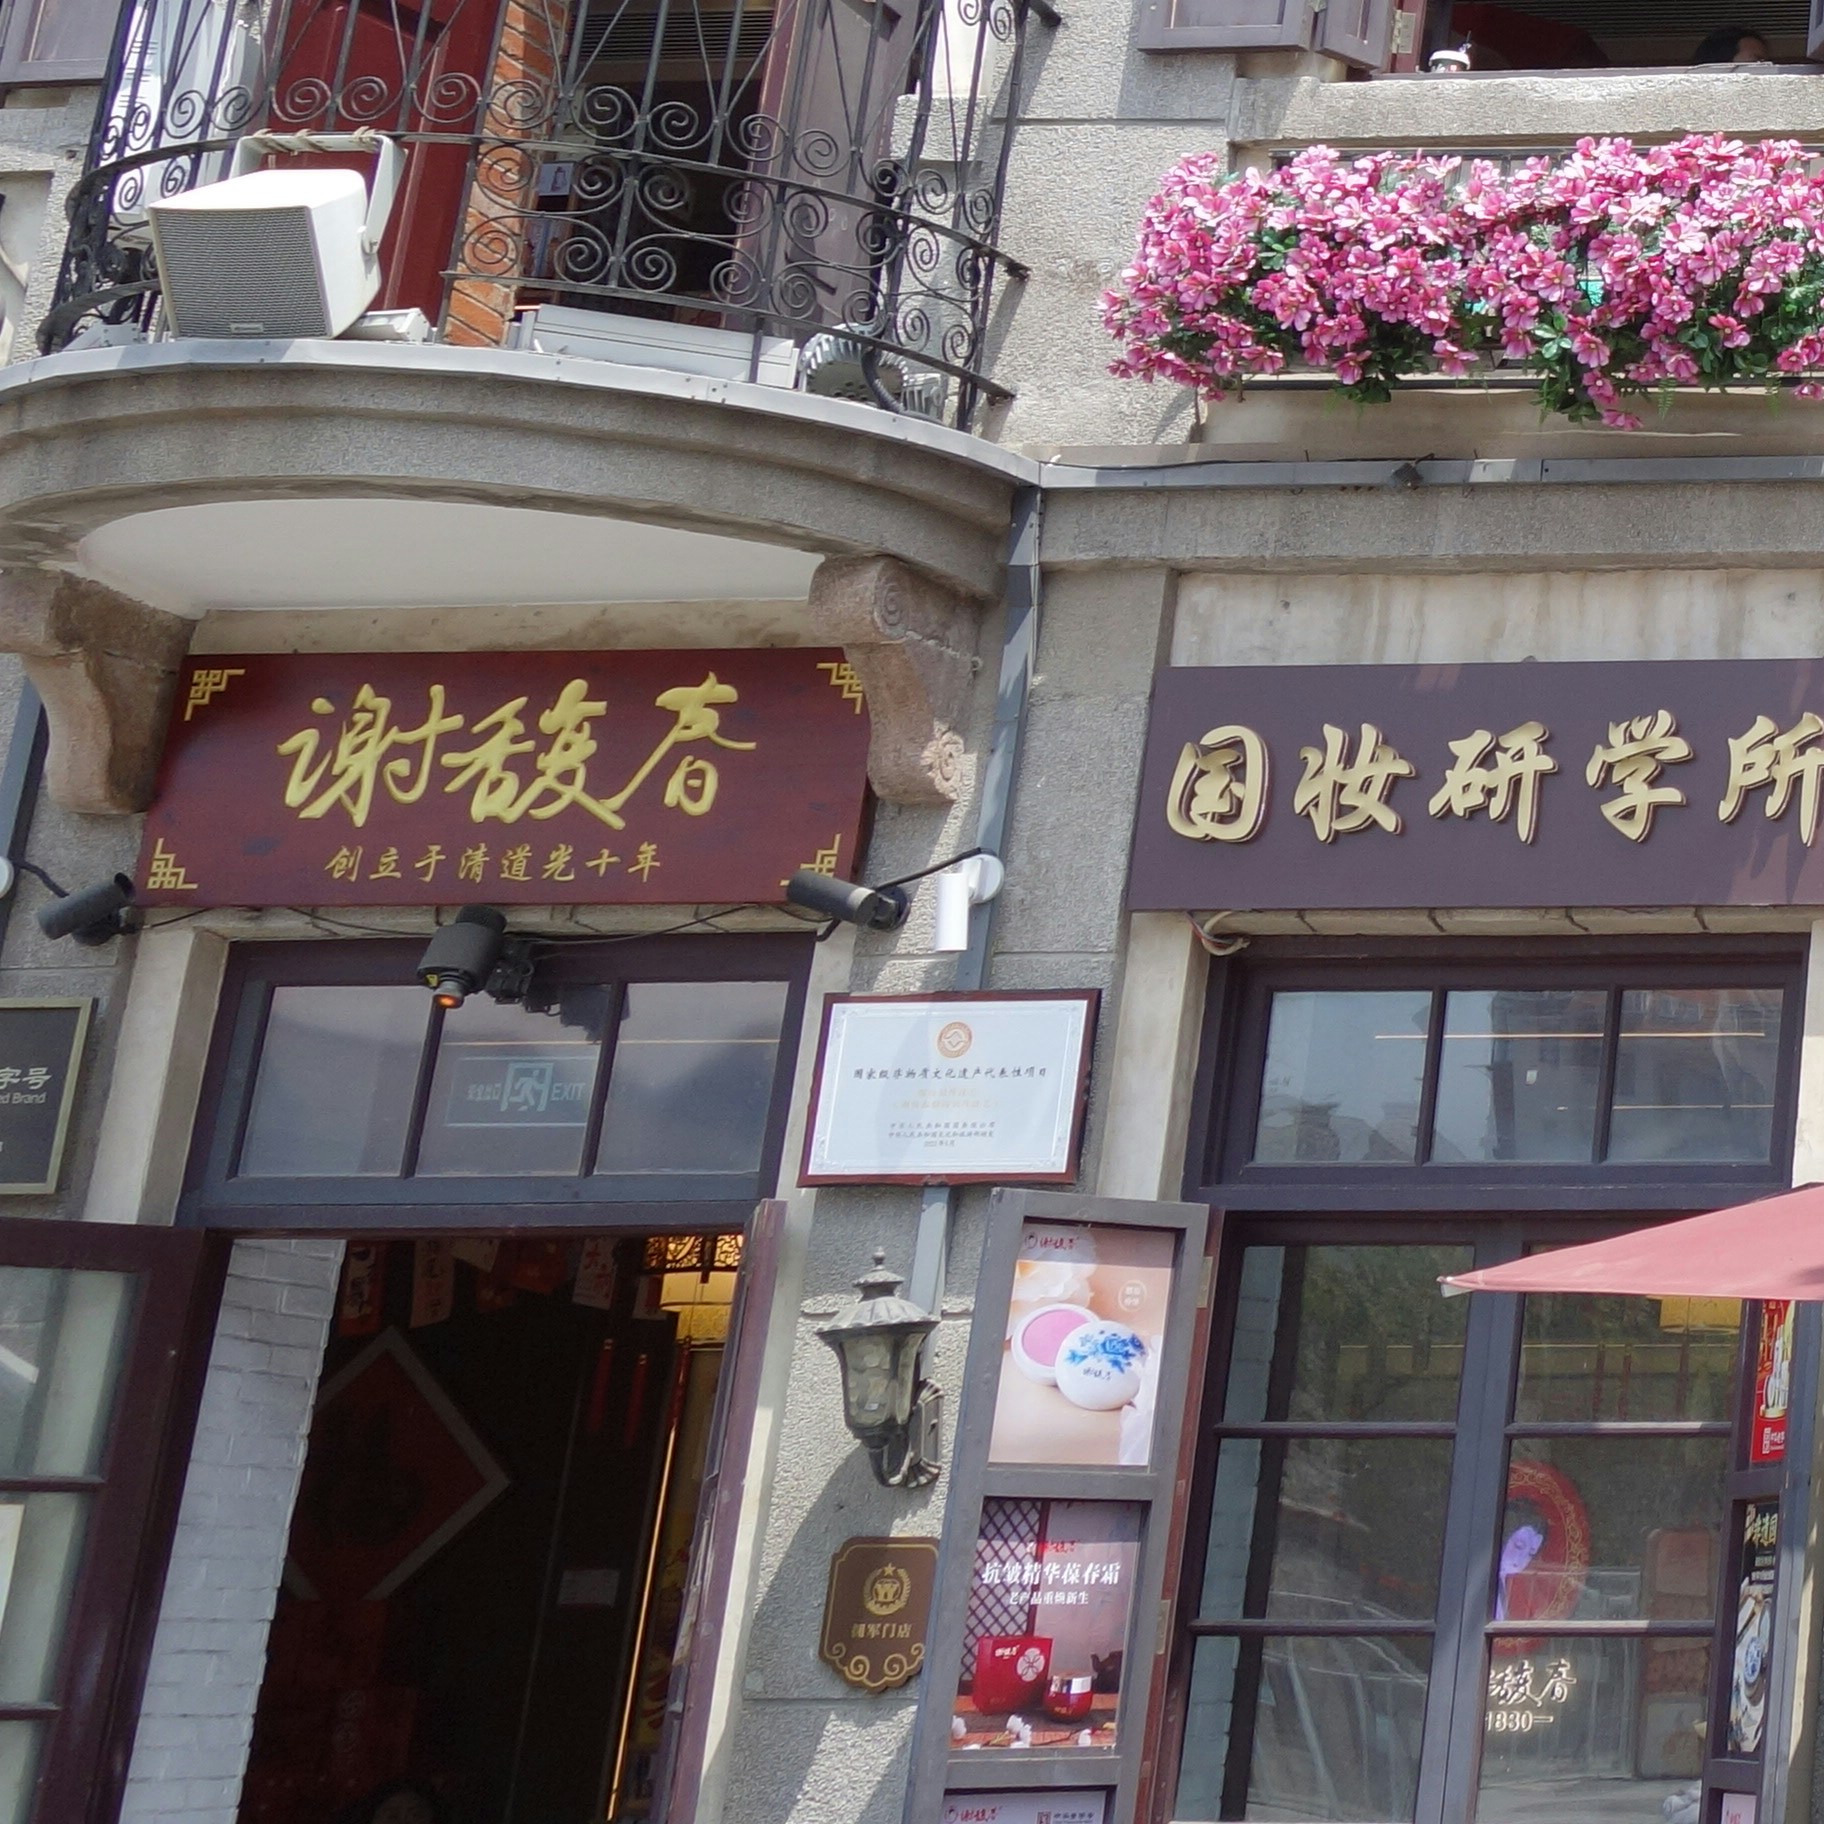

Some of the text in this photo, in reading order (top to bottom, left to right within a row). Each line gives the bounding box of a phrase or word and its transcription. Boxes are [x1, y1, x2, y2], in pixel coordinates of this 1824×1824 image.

[276, 670, 758, 831] 谢馥春
[325, 841, 662, 883] 创立于清道光十年
[12, 1092, 47, 1104] Brand
[551, 1082, 586, 1101] EXIT
